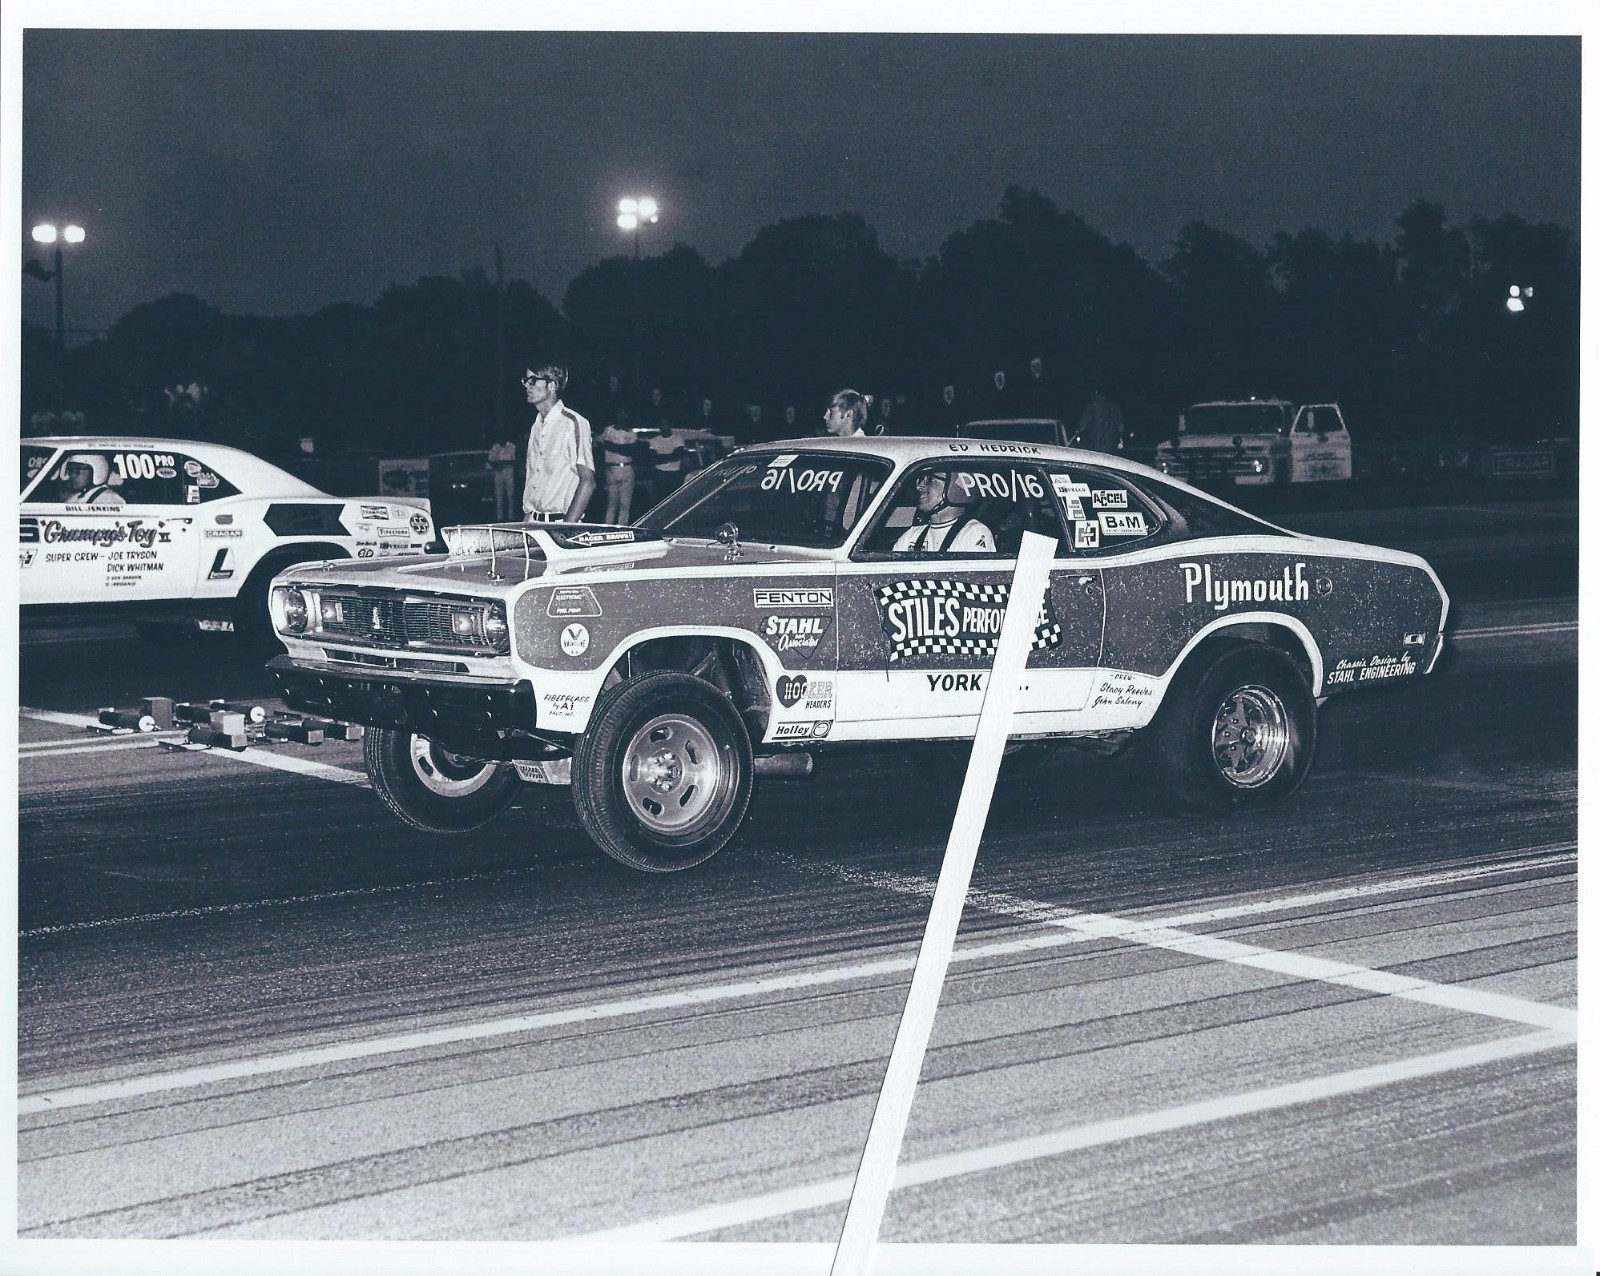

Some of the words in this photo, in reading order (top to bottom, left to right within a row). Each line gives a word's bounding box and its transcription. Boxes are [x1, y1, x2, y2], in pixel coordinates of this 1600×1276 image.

[949, 444, 968, 452] ED
[980, 444, 1041, 455] HEDRICK
[113, 453, 155, 480] 100
[154, 454, 175, 467] PRO
[957, 469, 1044, 503] PRO/16
[1093, 490, 1126, 507] ACCEL
[206, 530, 242, 538] CRAGAR
[45, 553, 71, 563] SUPER
[74, 552, 99, 562] CREW
[108, 552, 124, 561] JOE
[126, 550, 158, 560] TRYSON
[107, 563, 125, 573] DICK
[127, 562, 164, 572] WHITMAN
[1179, 562, 1310, 611] Plymouth
[755, 592, 832, 603] FENTON
[766, 615, 824, 636] STAHL
[888, 596, 960, 643] STILES
[1336, 657, 1367, 670] Chassis
[1370, 654, 1398, 667] Design
[1327, 669, 1355, 685] STAHL
[1359, 661, 1416, 681] ENGINEERING
[926, 673, 982, 692] YORK
[805, 699, 832, 710] HEADERS
[776, 725, 810, 737] Holley
